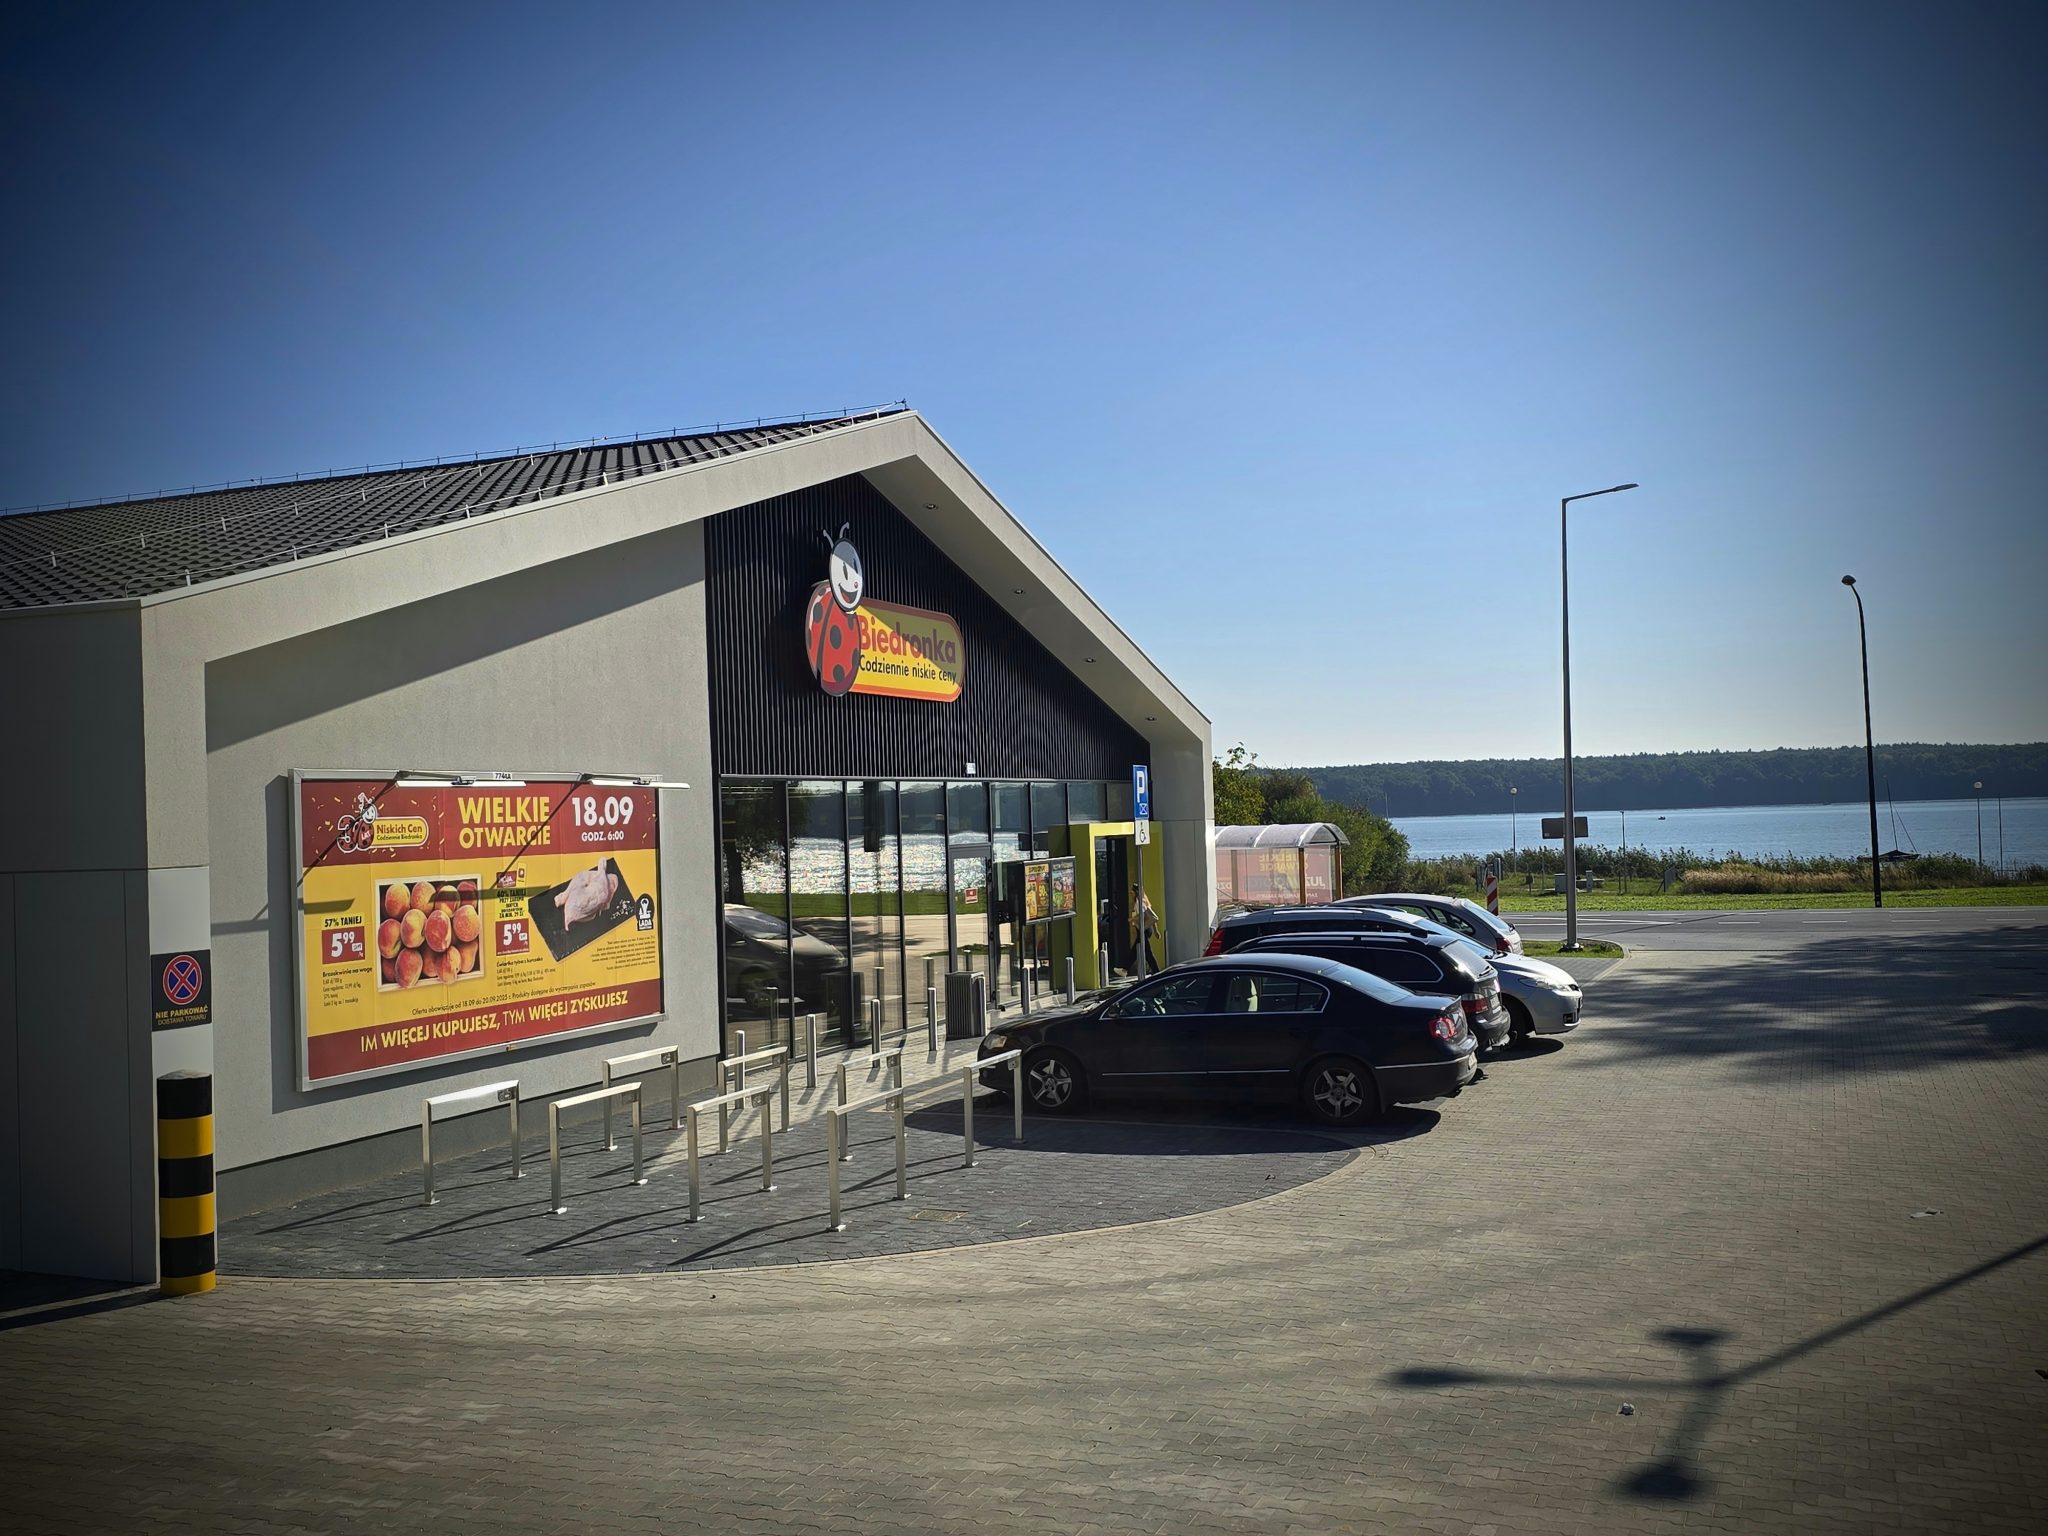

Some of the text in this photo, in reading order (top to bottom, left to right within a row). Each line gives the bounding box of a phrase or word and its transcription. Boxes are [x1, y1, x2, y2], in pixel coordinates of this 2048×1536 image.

[859, 613, 957, 665] Biedronka
[859, 654, 957, 685] Codziennie niskie ceny
[1136, 770, 1145, 803] P
[458, 796, 550, 824] WIELKIE
[572, 796, 634, 827] 18.09
[376, 823, 422, 834] Niskich Cen
[459, 825, 551, 849] OTWARCIE
[581, 830, 625, 842] GODZ. 6:00
[324, 916, 362, 928] 57% TANIEJ
[155, 1004, 208, 1019] NIE PARKOWAĆ
[411, 1007, 427, 1016] Oferta
[455, 1001, 461, 1009] od
[512, 990, 530, 999] Produkty
[361, 990, 628, 1052] IM WIĘCEJ KUPUJESZ, TYM WIĘCEJ ZYSKUJESZ
